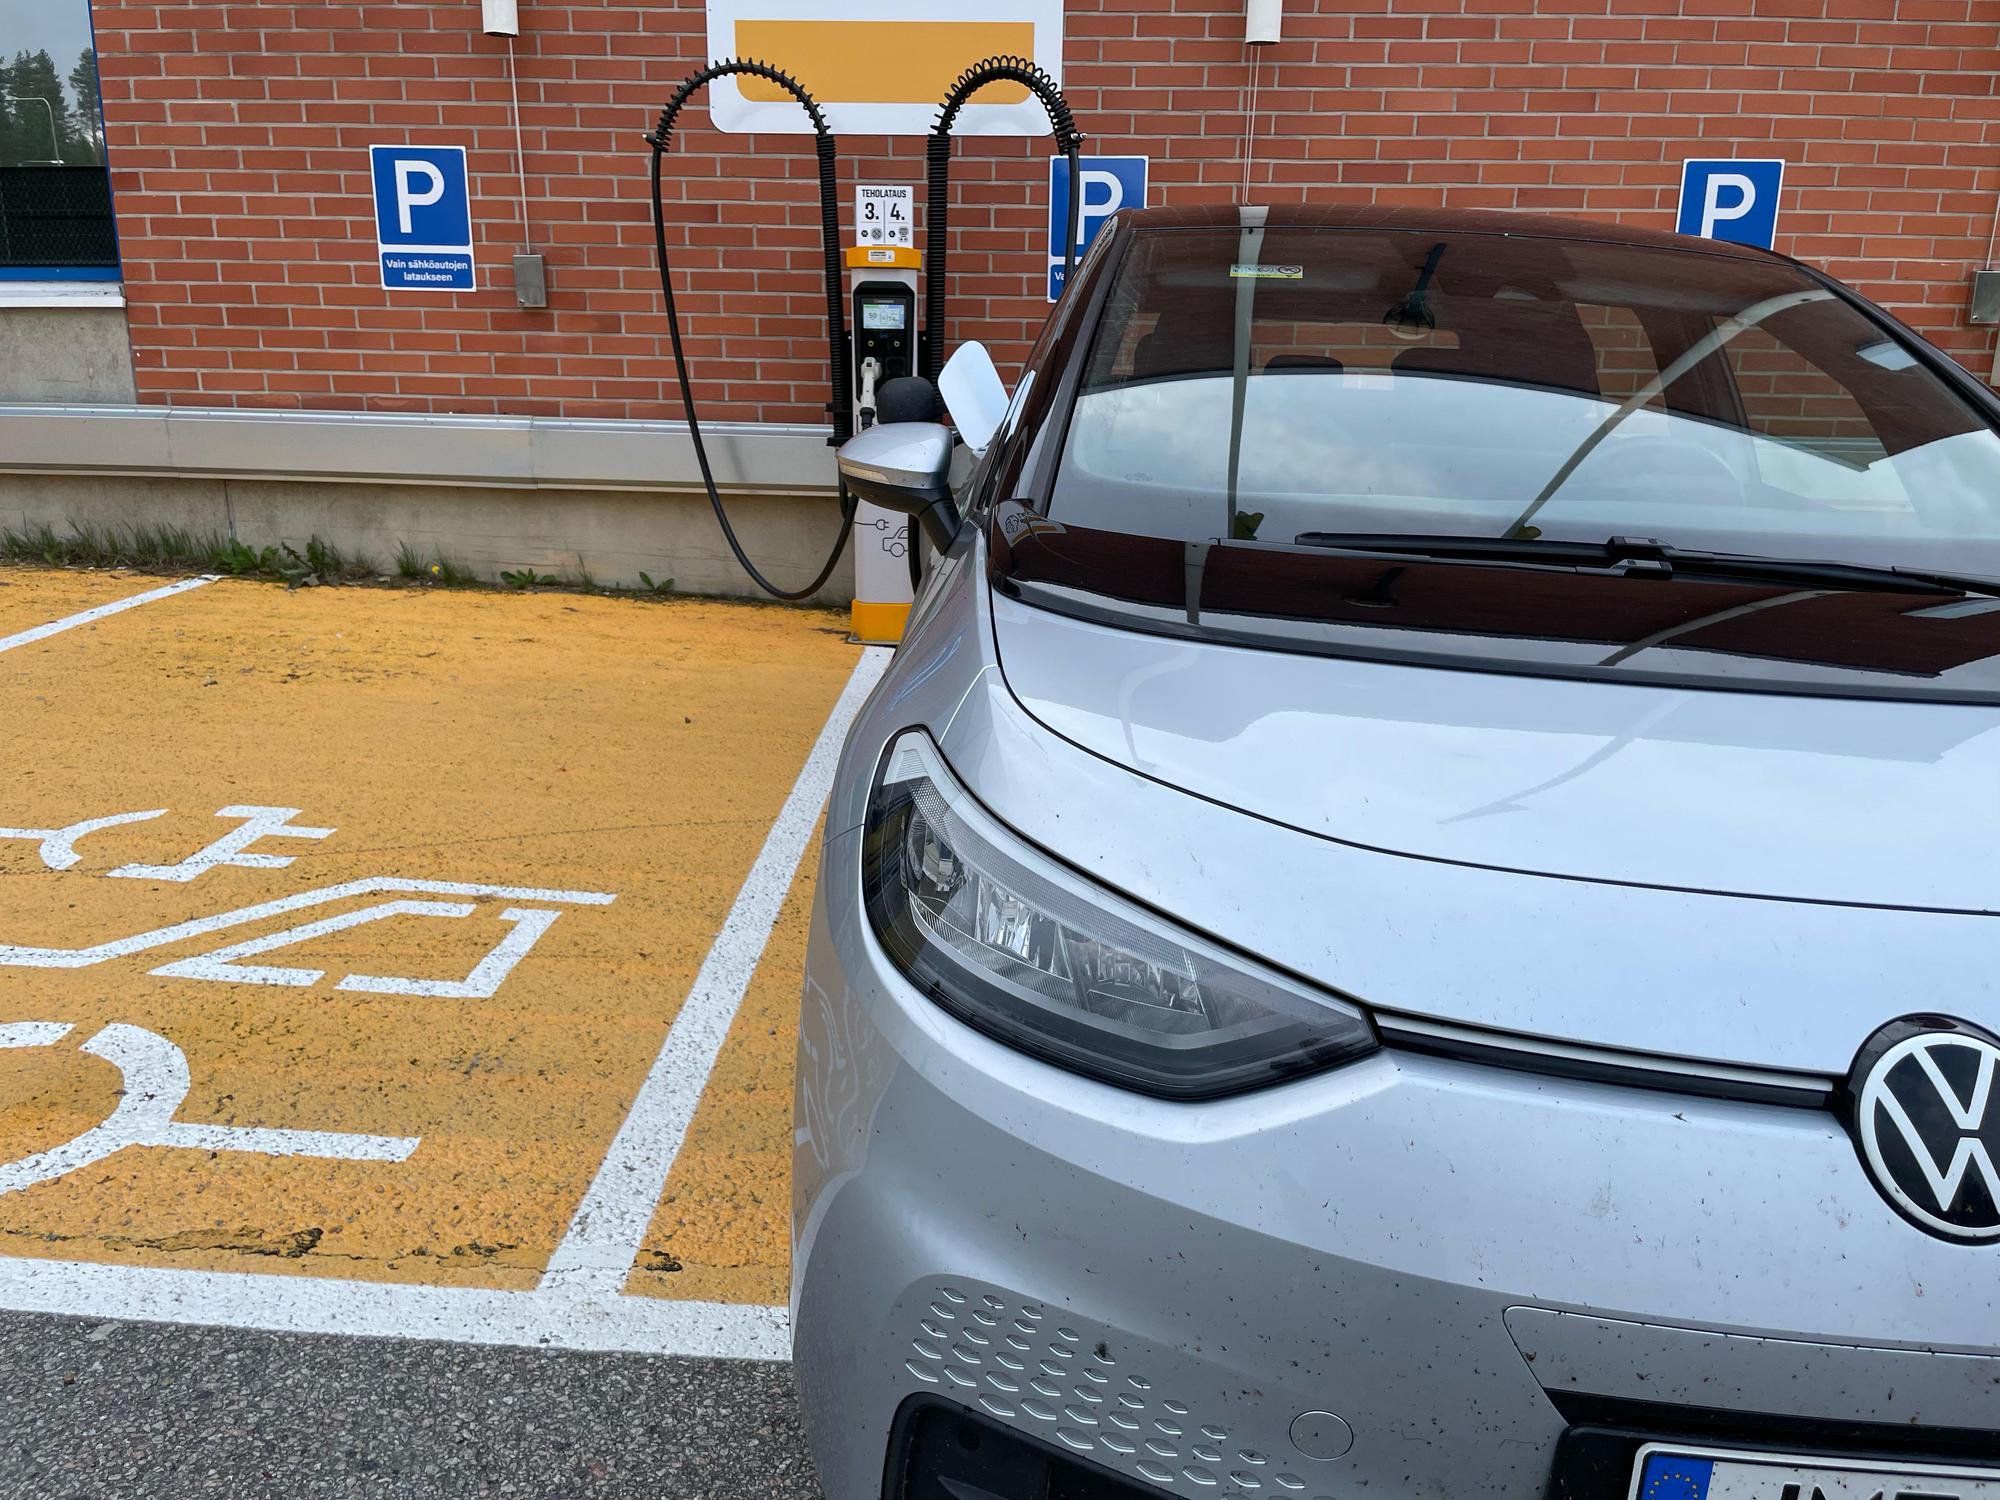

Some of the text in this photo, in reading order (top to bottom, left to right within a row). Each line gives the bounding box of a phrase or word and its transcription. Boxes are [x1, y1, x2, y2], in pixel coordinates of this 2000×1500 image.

[394, 160, 445, 233] P
[862, 189, 907, 198] TEHOLATAUS
[865, 202, 879, 220] 3.
[890, 203, 905, 221] 4.
[1076, 171, 1123, 245] P
[1700, 173, 1756, 239] P
[386, 259, 468, 271] Vain sähköautojen
[404, 272, 453, 281] lataukseen
[1868, 1040, 2000, 1220] VW
